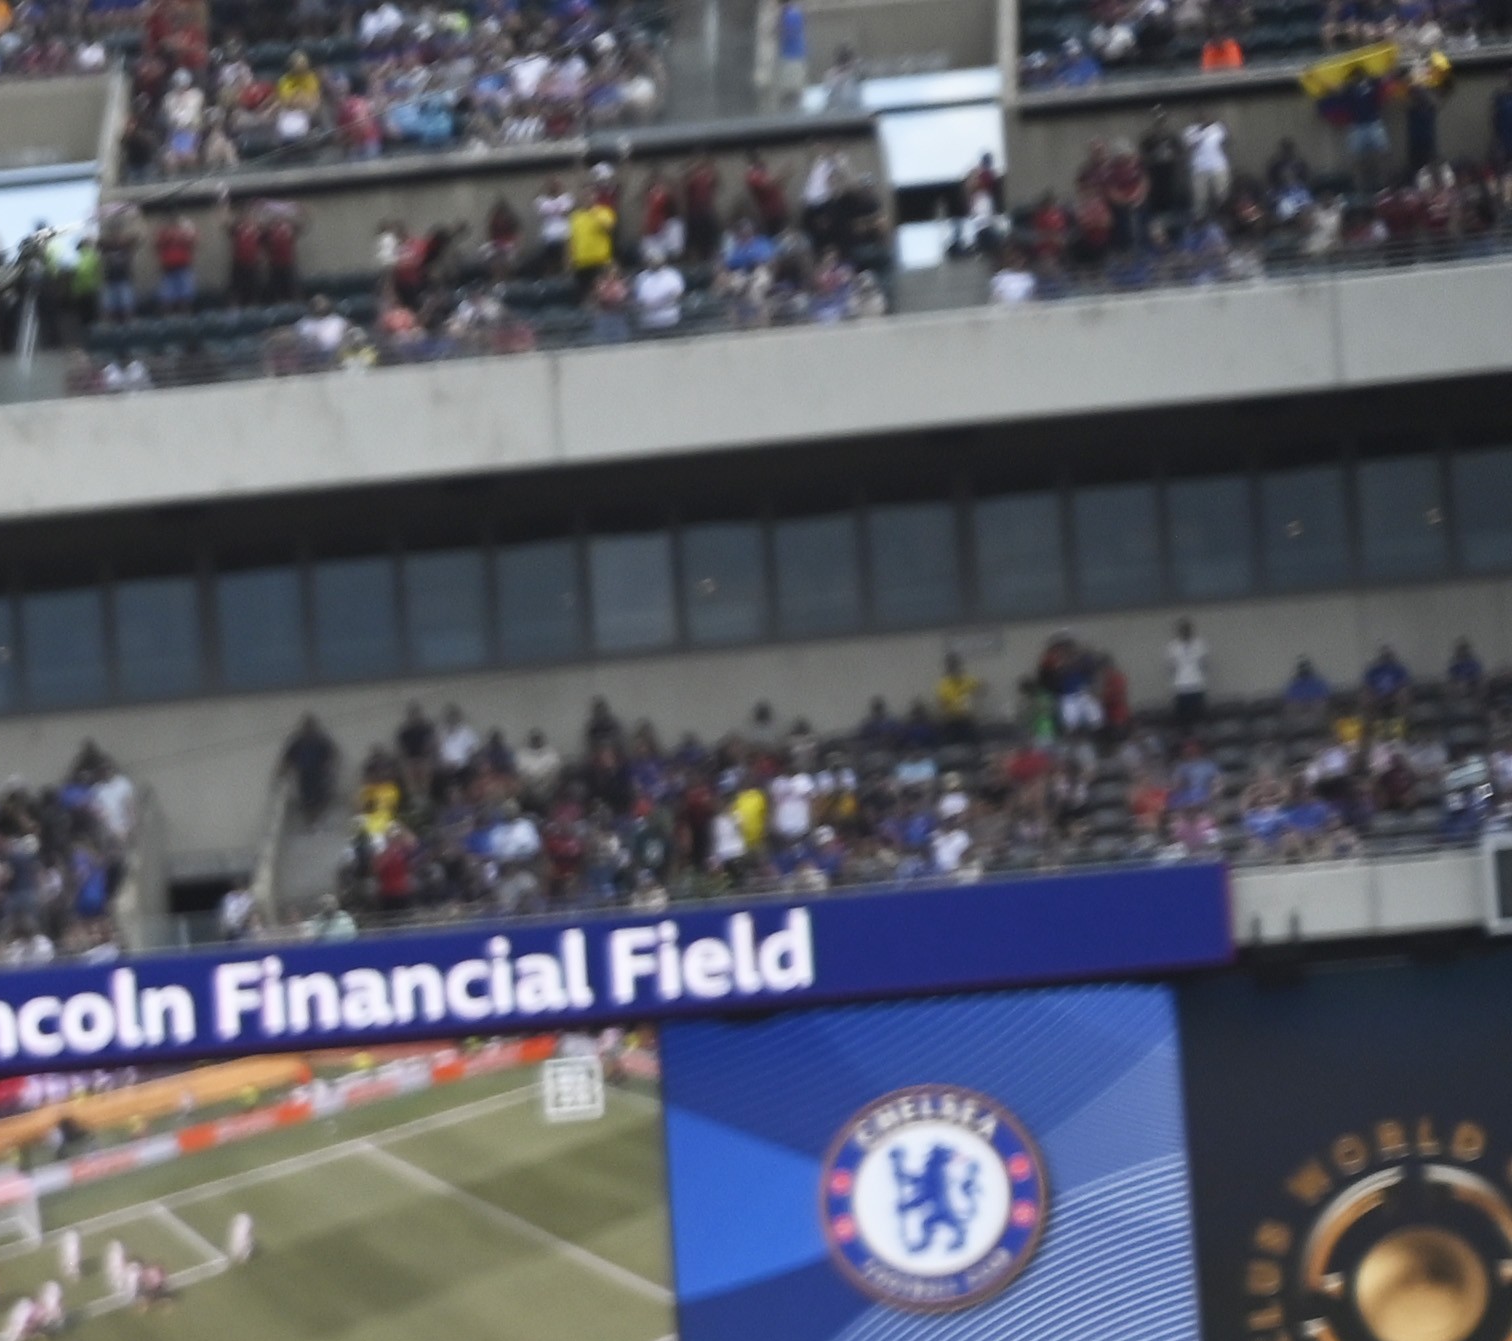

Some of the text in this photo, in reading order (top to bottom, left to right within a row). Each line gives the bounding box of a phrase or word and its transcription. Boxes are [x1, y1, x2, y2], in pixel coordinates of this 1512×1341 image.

[214, 935, 595, 1042] Financial
[608, 905, 816, 1003] Field
[854, 1093, 999, 1146] CHELSEA
[1283, 1113, 1489, 1207] WORLD
